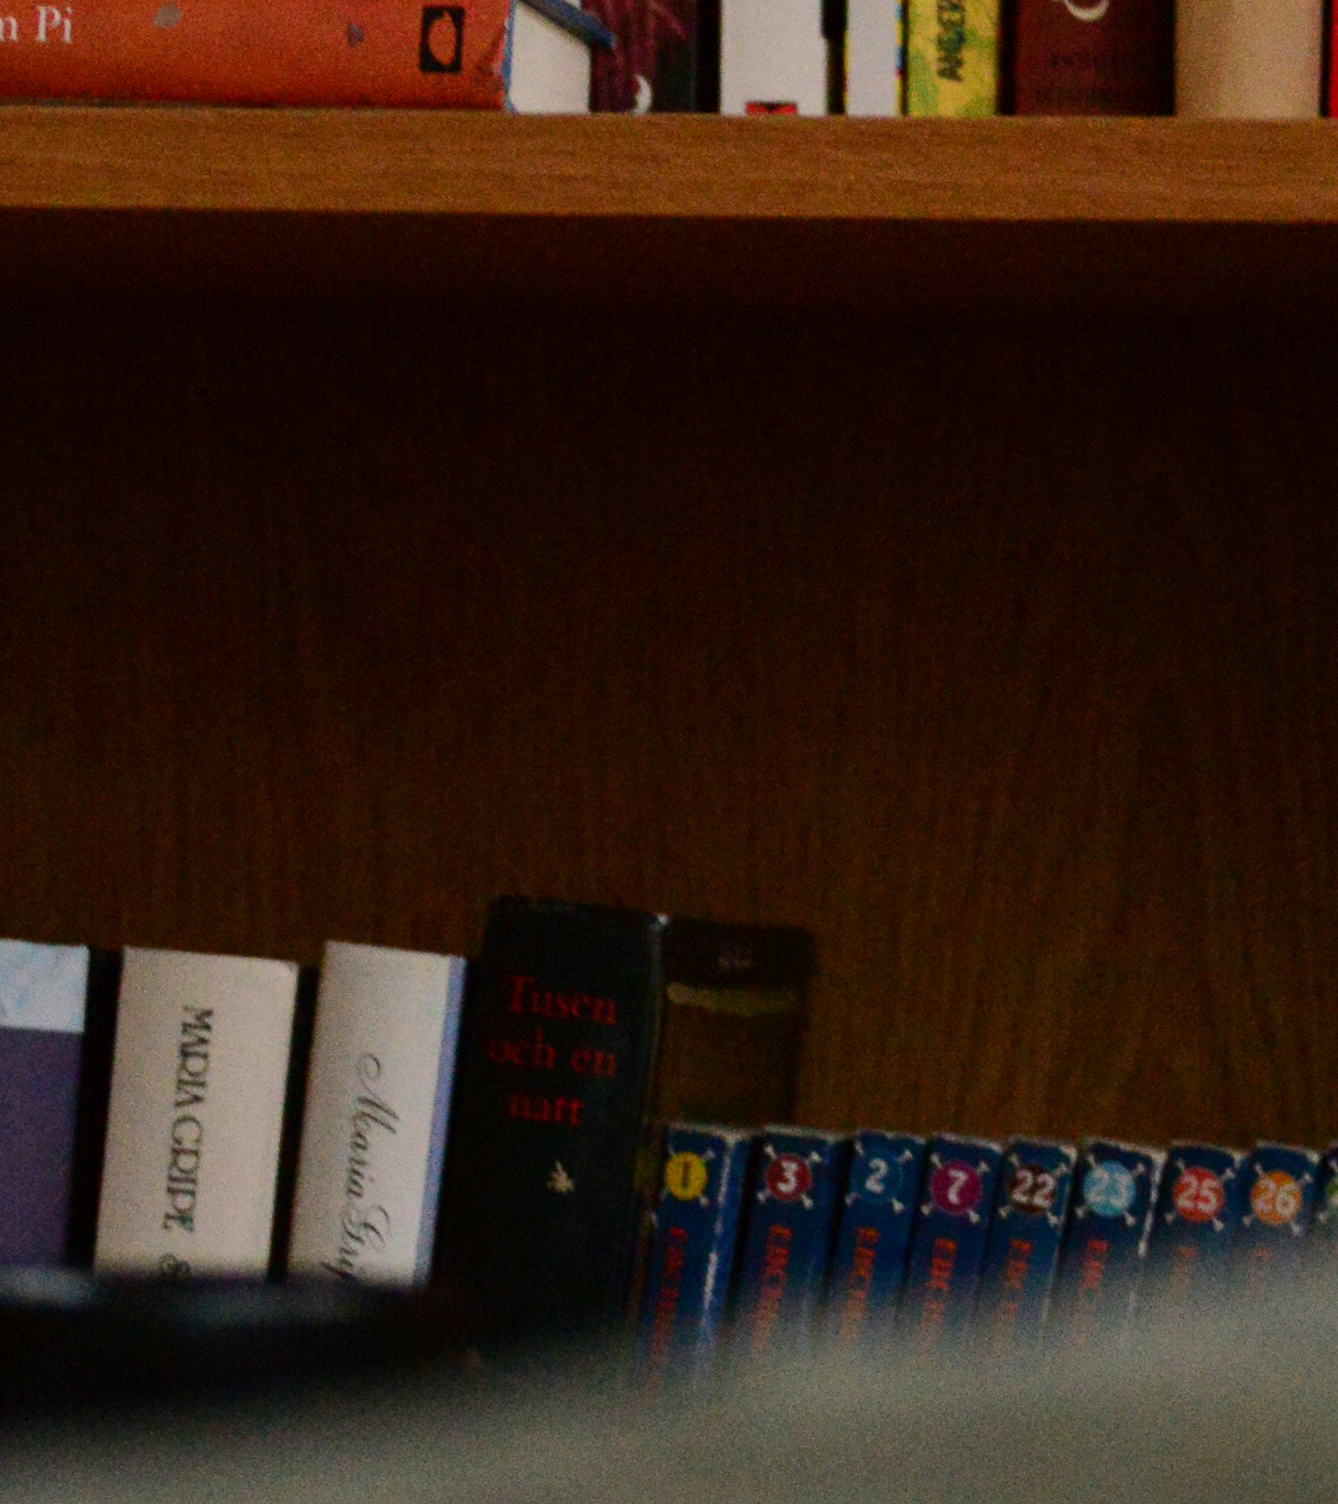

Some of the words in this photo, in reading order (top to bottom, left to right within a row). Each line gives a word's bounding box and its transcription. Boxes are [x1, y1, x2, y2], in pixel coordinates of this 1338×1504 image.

[34, 3, 73, 42] Pi
[502, 972, 617, 1026] Tusen
[173, 1004, 215, 1110] MARIA
[778, 1162, 801, 1193] 3
[865, 1160, 890, 1191] 2
[1015, 1172, 1057, 1209] 22
[1089, 1172, 1130, 1209] 23
[1171, 1174, 1219, 1212] 25
[1259, 1176, 1297, 1215] 26
